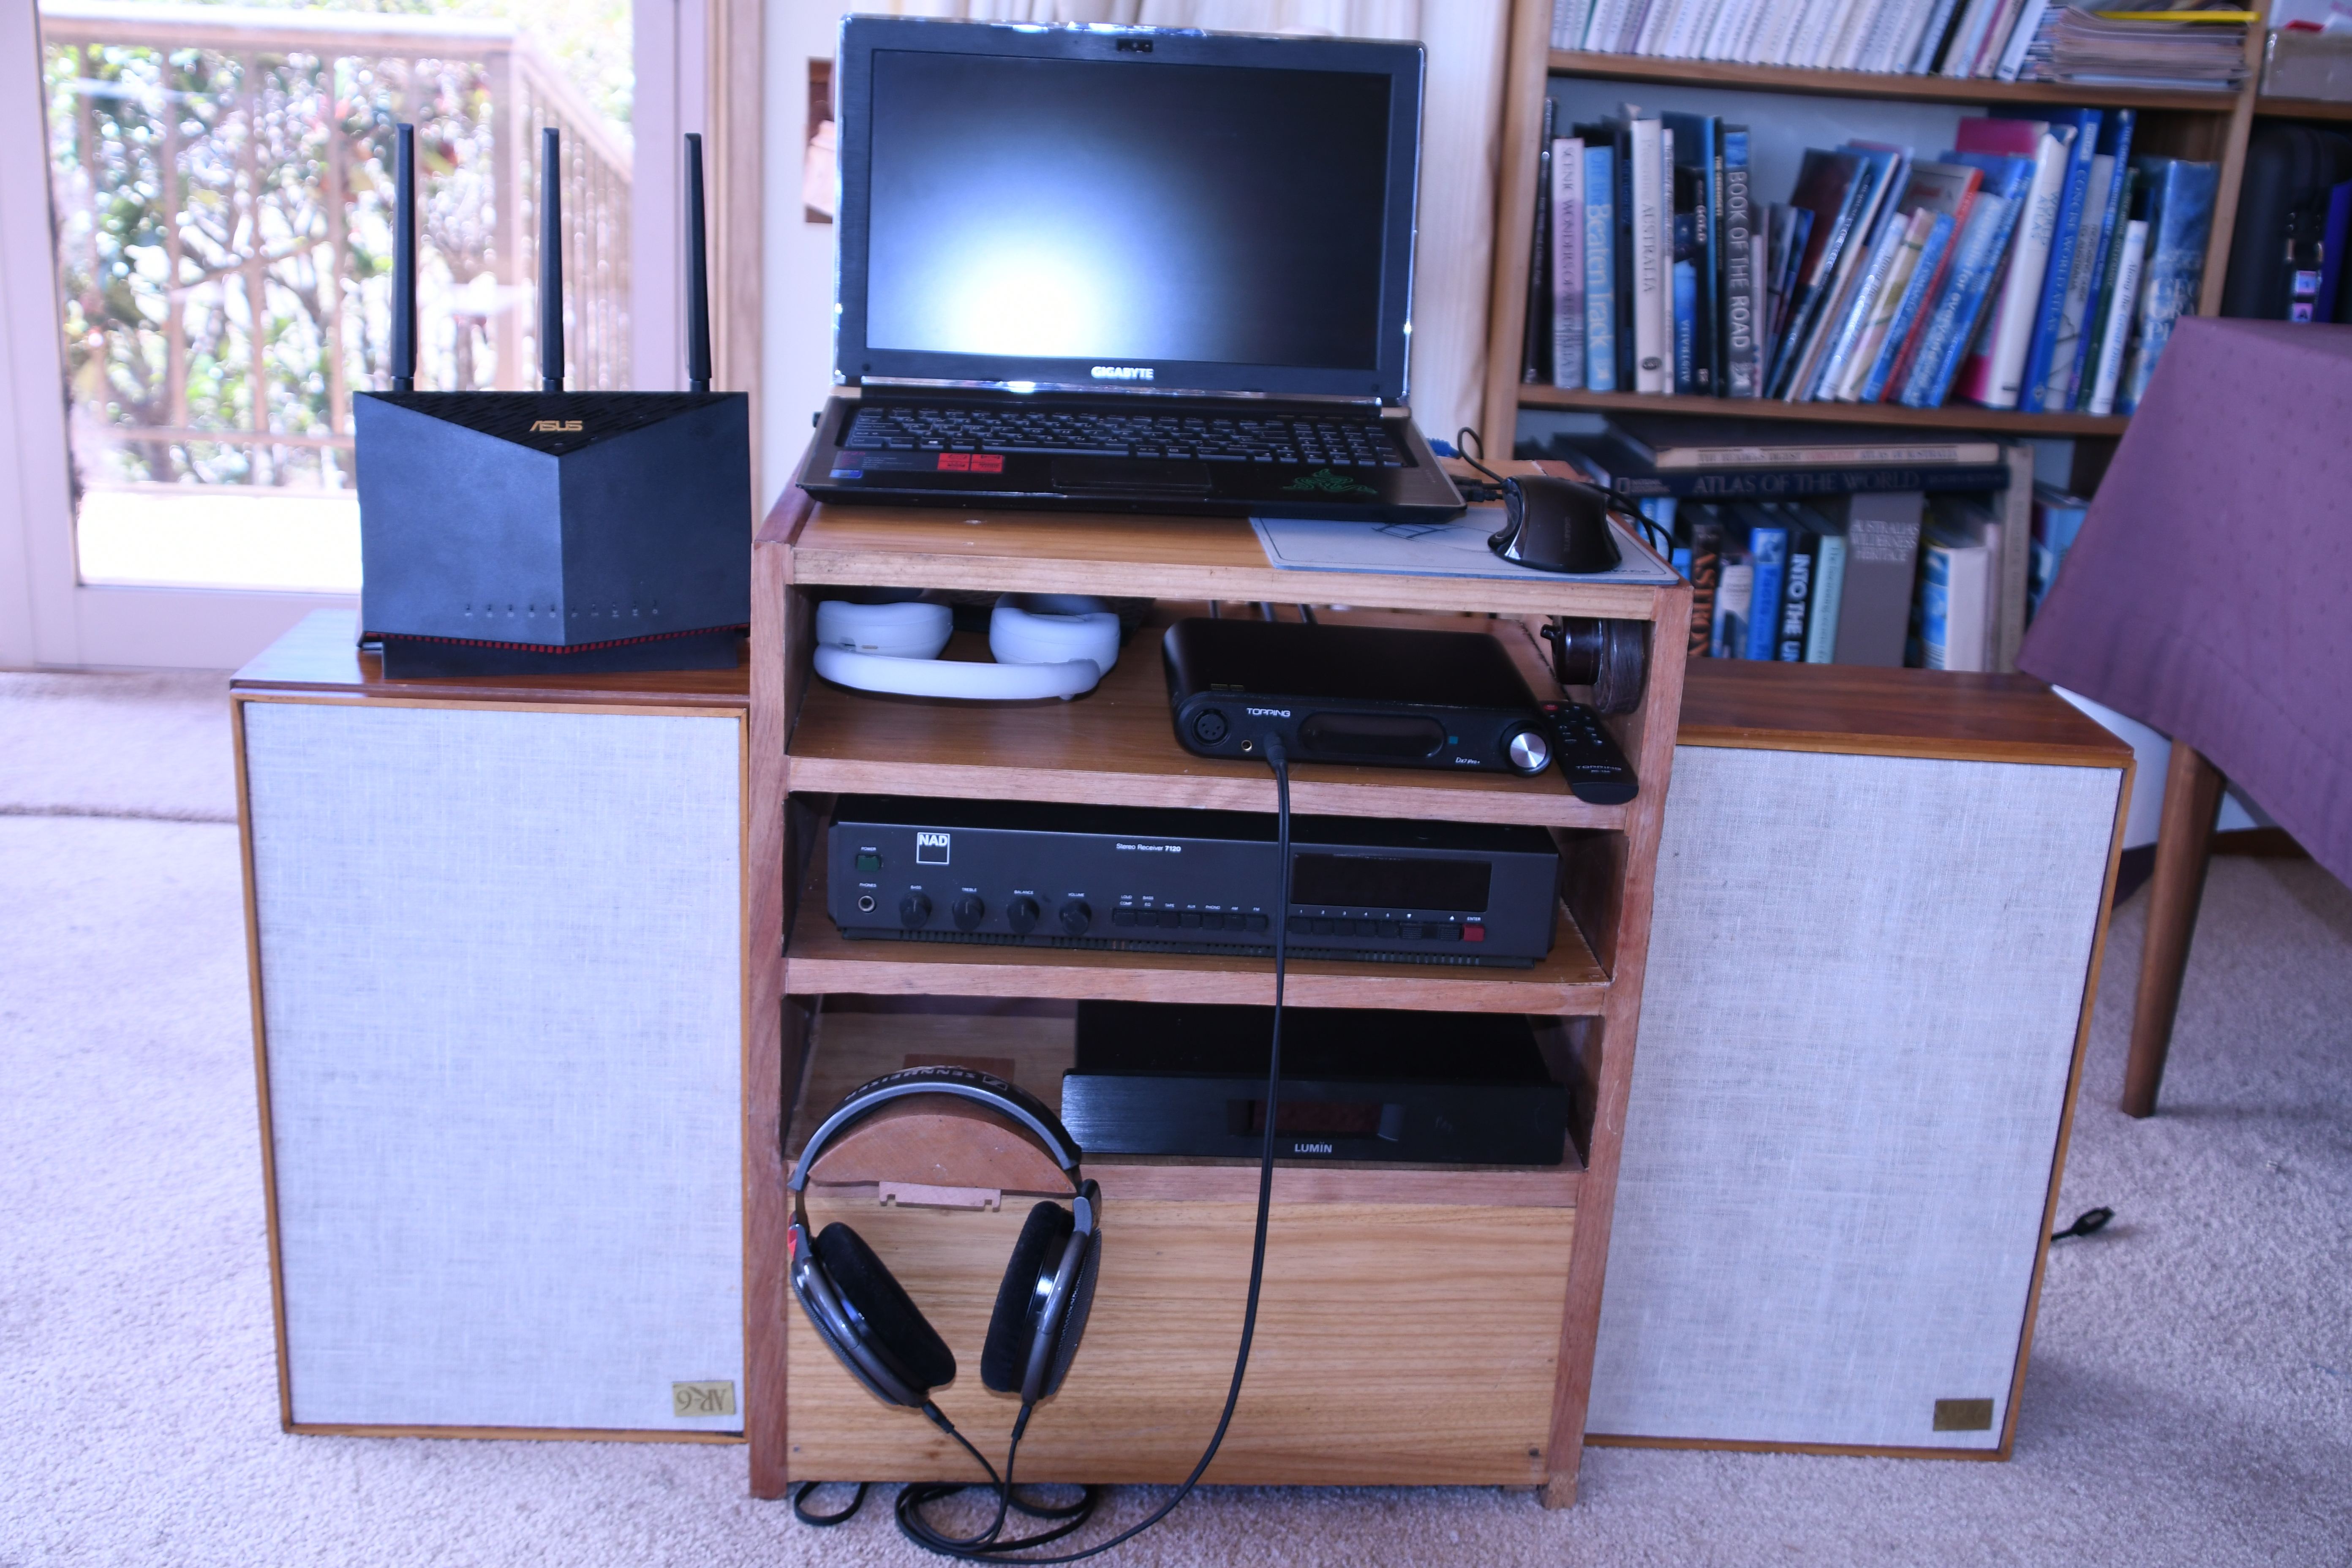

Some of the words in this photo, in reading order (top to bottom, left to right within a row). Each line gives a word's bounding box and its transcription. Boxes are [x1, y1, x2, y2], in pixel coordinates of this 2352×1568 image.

[1562, 147, 1574, 195] SCENIC
[1728, 172, 1748, 220] BOOK
[2067, 169, 2088, 229] CONCISE
[1562, 200, 1574, 269] WONDERS
[1587, 204, 1612, 285] Beaten
[1642, 204, 1655, 293] AUSTRALIA
[1731, 227, 1749, 248] OF
[1731, 255, 1750, 286] THE
[1954, 267, 1973, 291] for
[2053, 234, 2075, 287] WORLD
[2123, 260, 2137, 291] Along
[1589, 293, 1614, 348] Track
[1732, 296, 1750, 347] ROAD
[2045, 290, 2063, 331] ATLAS
[2120, 294, 2131, 311] the
[1562, 291, 1575, 367] AUSTRALIA
[2113, 313, 2128, 344] Great
[1681, 320, 1690, 382] AUSTRALIA
[1091, 366, 1154, 379] GIGABYTE
[530, 420, 583, 431] ASUS
[1691, 476, 1756, 494] ATLAS
[1760, 474, 1789, 493] OF
[1794, 473, 1838, 492] THE
[1841, 471, 1921, 490] WORLD
[1787, 553, 1811, 600] INTO
[1783, 601, 1806, 636] THE
[1247, 708, 1290, 717] TOPPING
[919, 834, 947, 846] NAD
[844, 1068, 975, 1101] SENNHEISER
